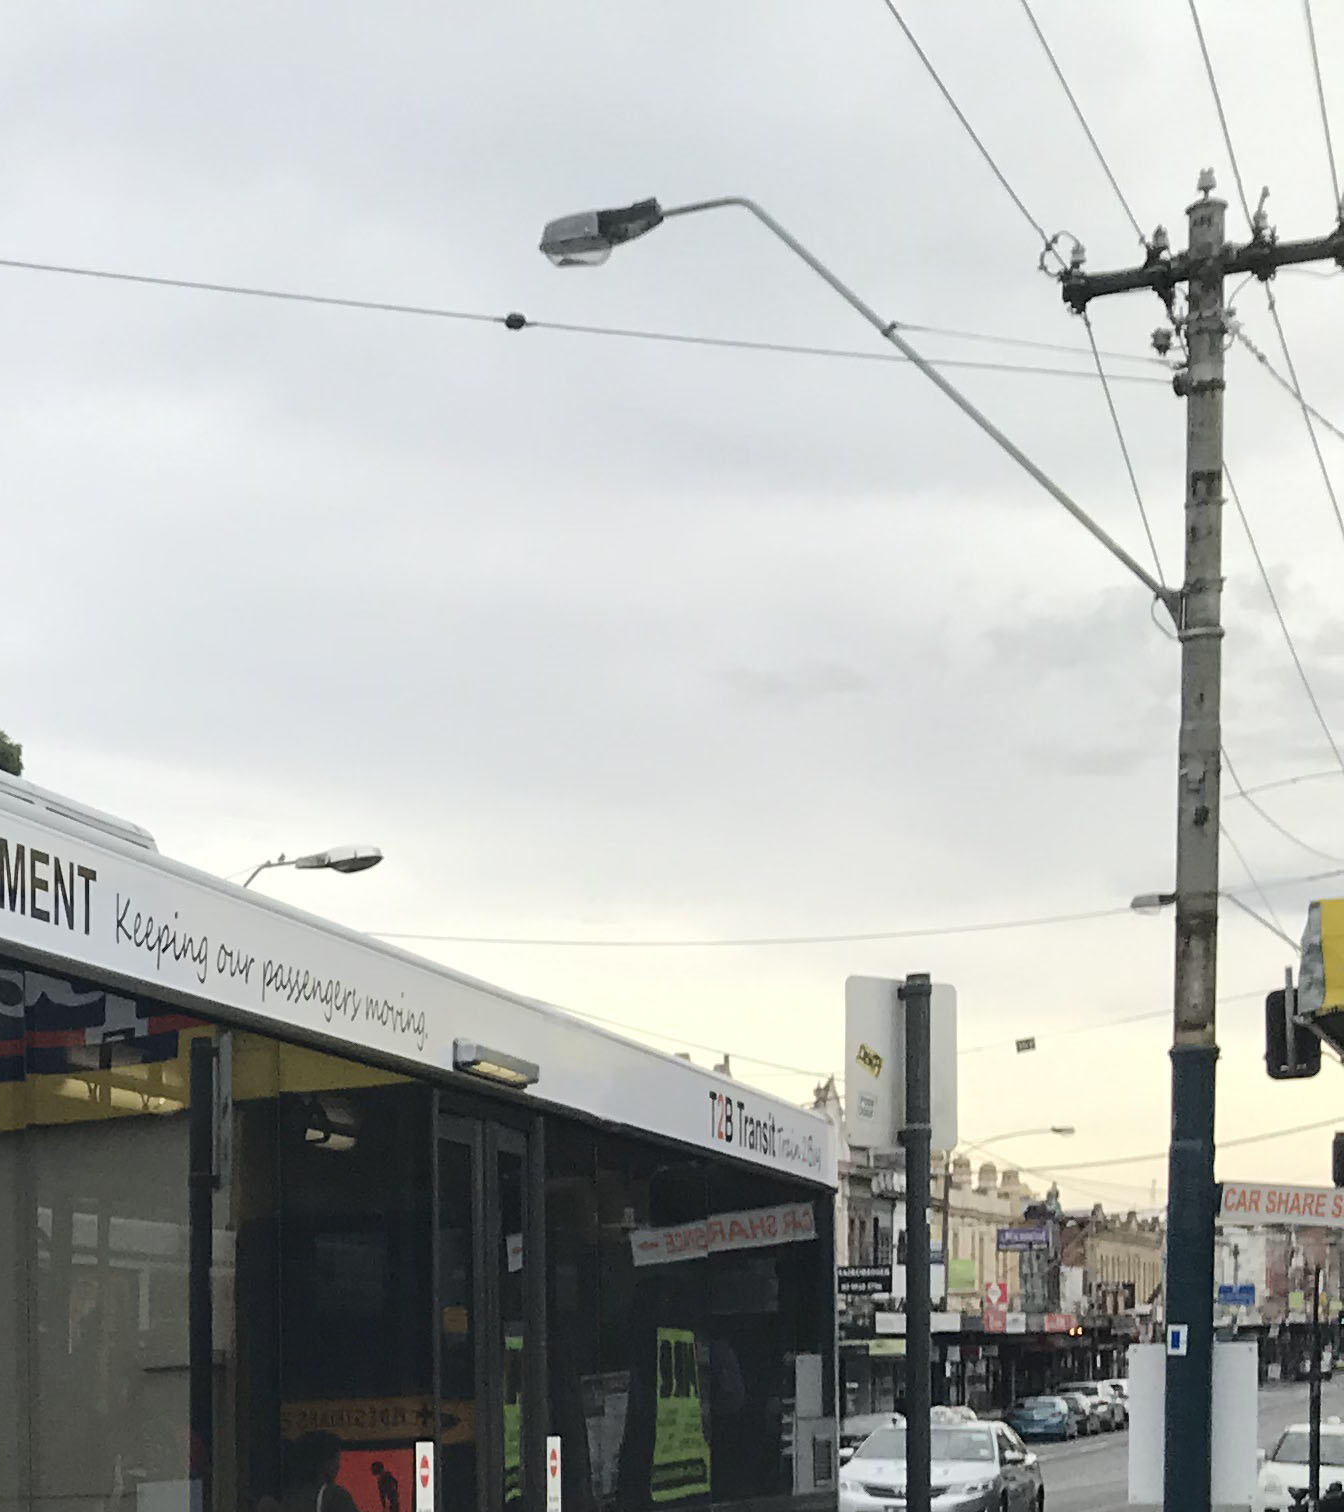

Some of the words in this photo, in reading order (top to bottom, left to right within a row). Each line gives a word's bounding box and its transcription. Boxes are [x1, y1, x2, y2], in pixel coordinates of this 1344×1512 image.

[115, 892, 208, 984] Keeping
[217, 942, 255, 984] our
[261, 957, 361, 1023] passengers
[709, 1090, 734, 1143] T2B
[737, 1101, 776, 1158] Transit
[1224, 1187, 1262, 1214] CAR
[1265, 1189, 1326, 1218] SHARE
